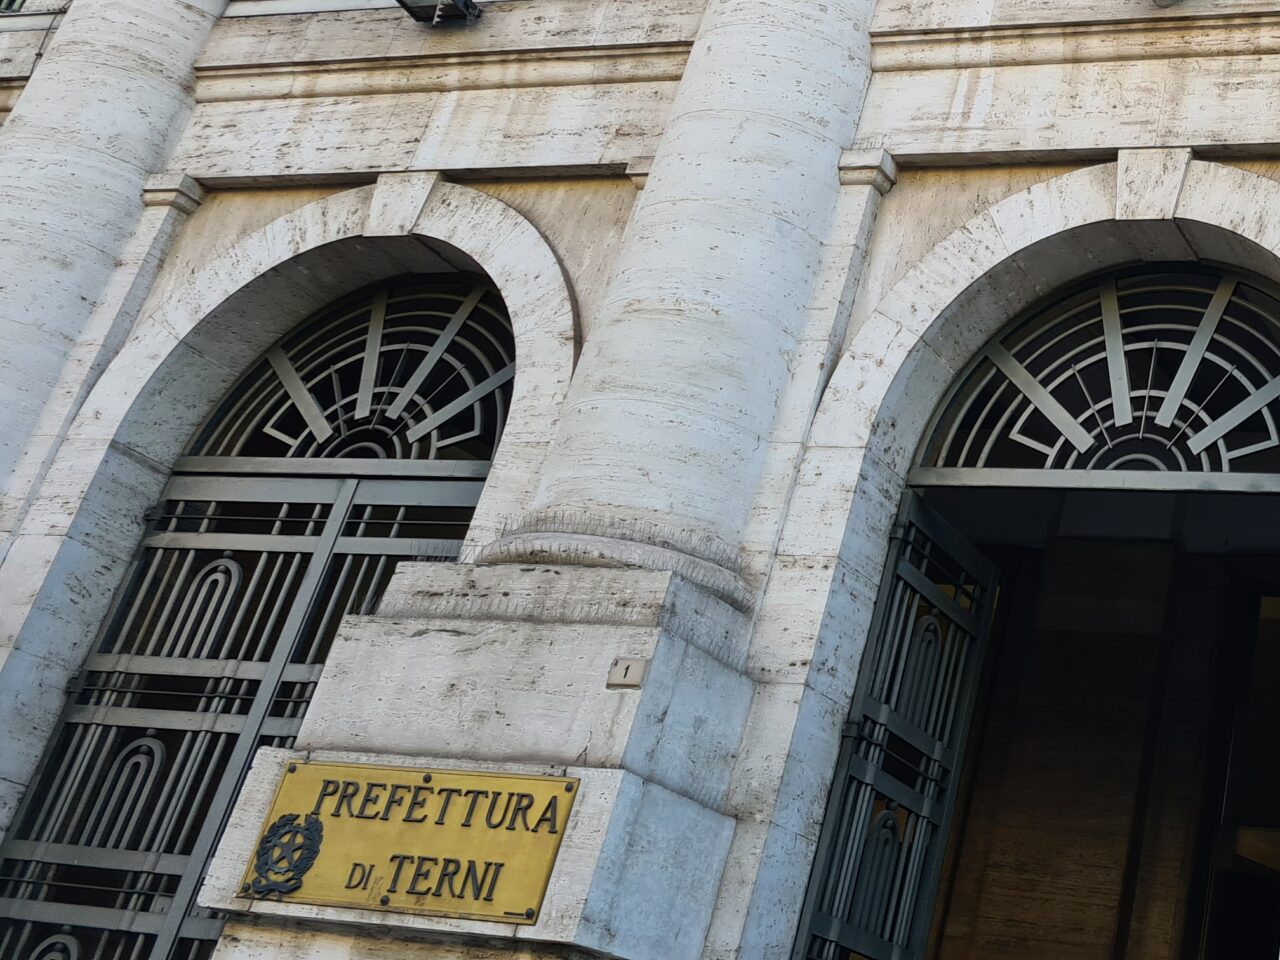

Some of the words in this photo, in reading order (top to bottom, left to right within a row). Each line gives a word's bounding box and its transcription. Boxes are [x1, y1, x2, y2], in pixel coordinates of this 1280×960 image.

[622, 663, 631, 680] 1
[311, 778, 559, 835] PREFETTURA
[344, 862, 375, 891] DI
[386, 853, 505, 902] TERNI
